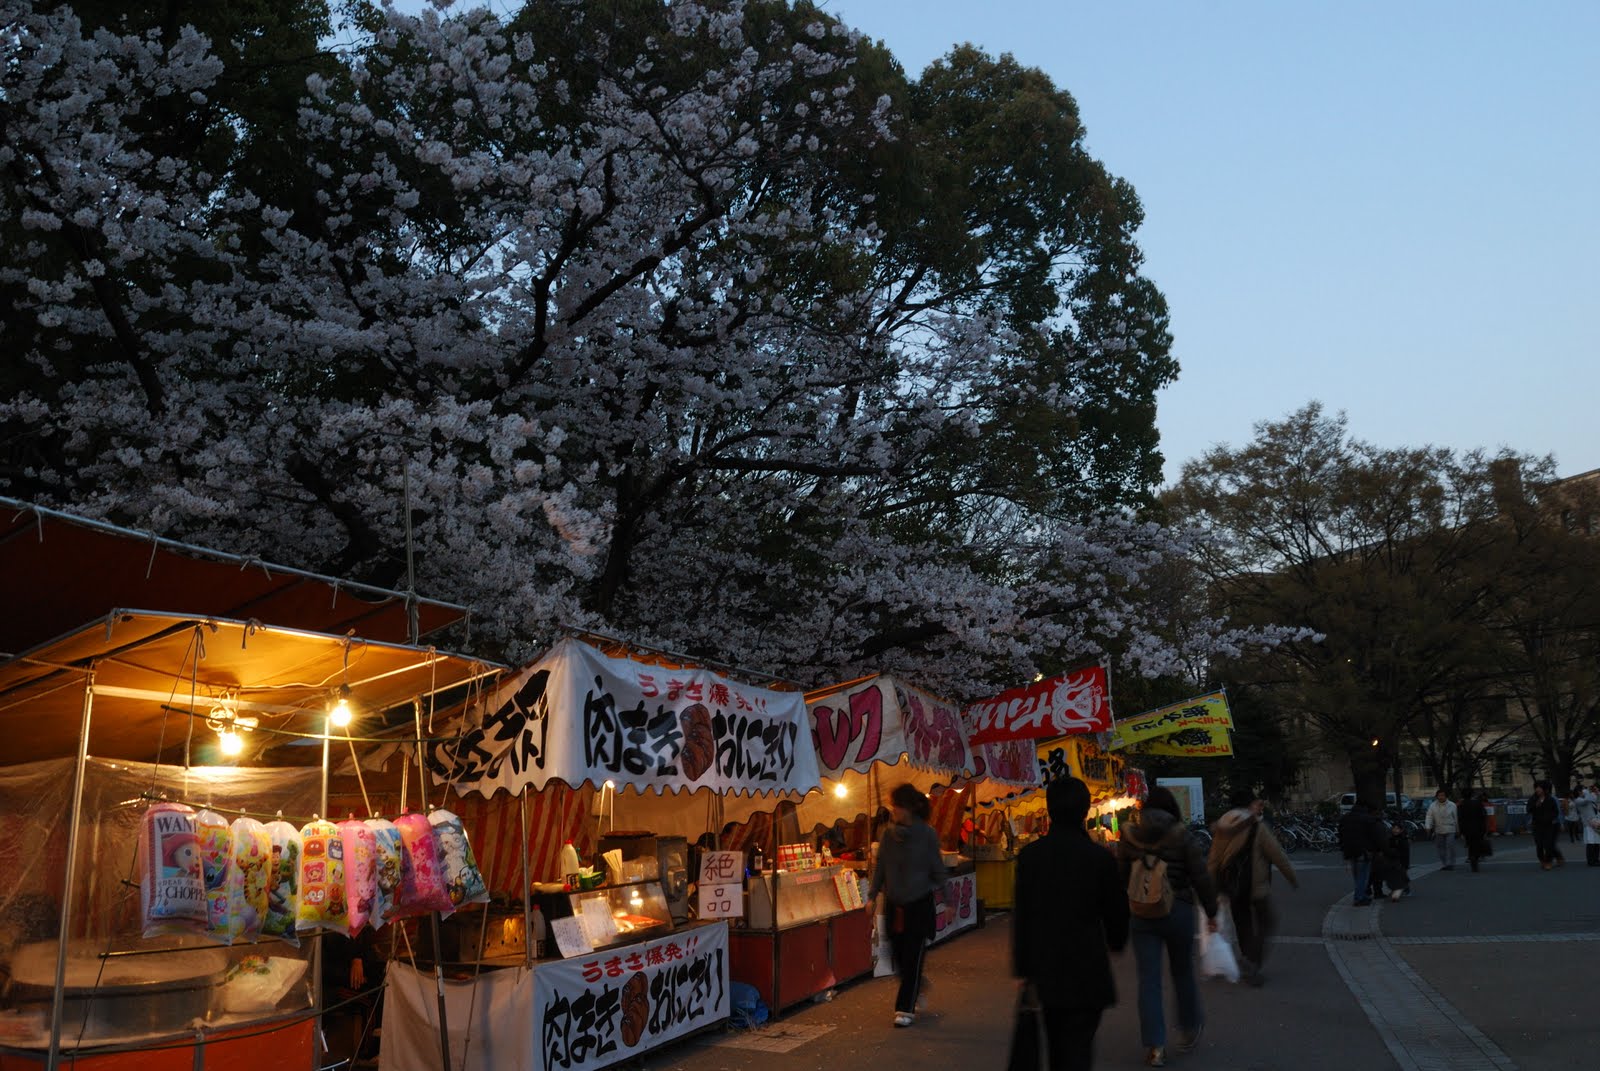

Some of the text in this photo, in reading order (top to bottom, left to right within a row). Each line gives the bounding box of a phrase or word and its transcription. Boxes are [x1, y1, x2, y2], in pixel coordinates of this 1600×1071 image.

[704, 853, 735, 913] 絶品
[582, 935, 699, 983] うまさ爆発!!
